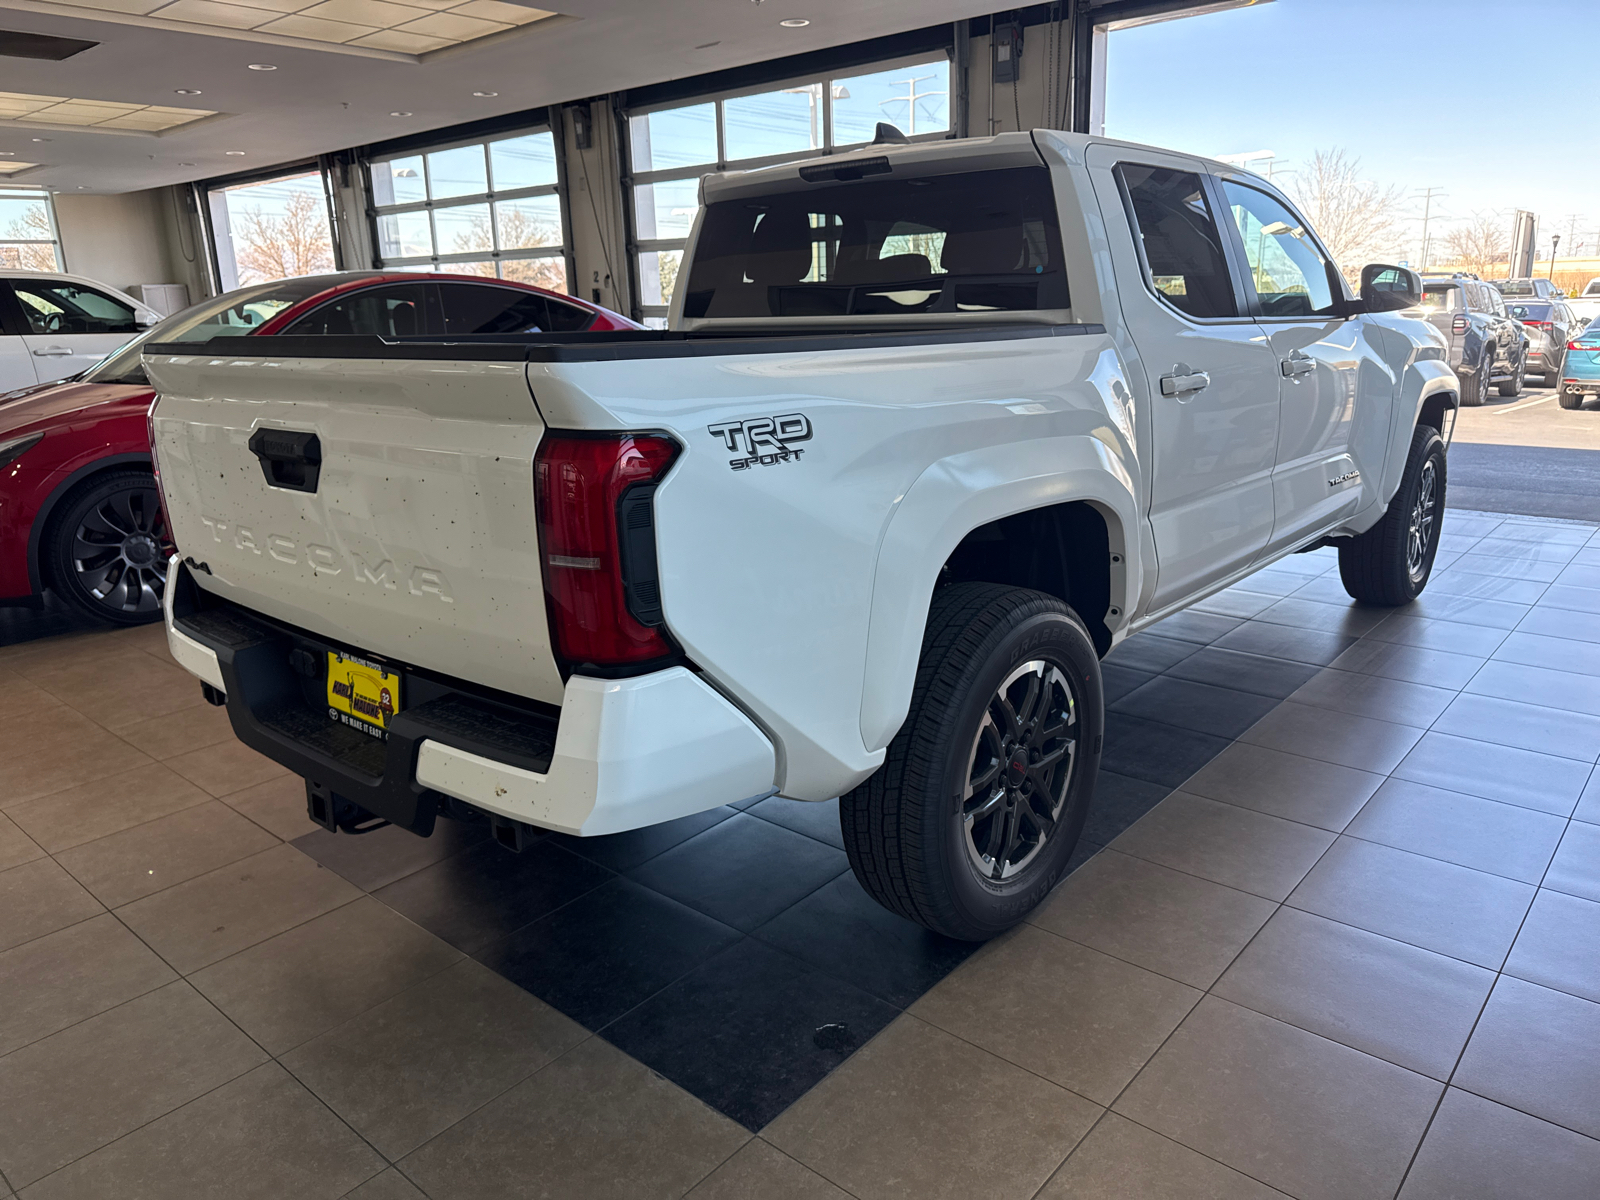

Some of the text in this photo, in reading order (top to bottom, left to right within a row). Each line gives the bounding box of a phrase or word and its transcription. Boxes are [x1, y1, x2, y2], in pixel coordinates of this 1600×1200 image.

[593, 271, 599, 283] 2
[707, 413, 814, 457] TRD
[729, 449, 805, 471] SPORT
[1328, 470, 1360, 487] TACOMA
[201, 514, 454, 603] TACOMA
[341, 714, 382, 739] WE MAKE IT EASY
